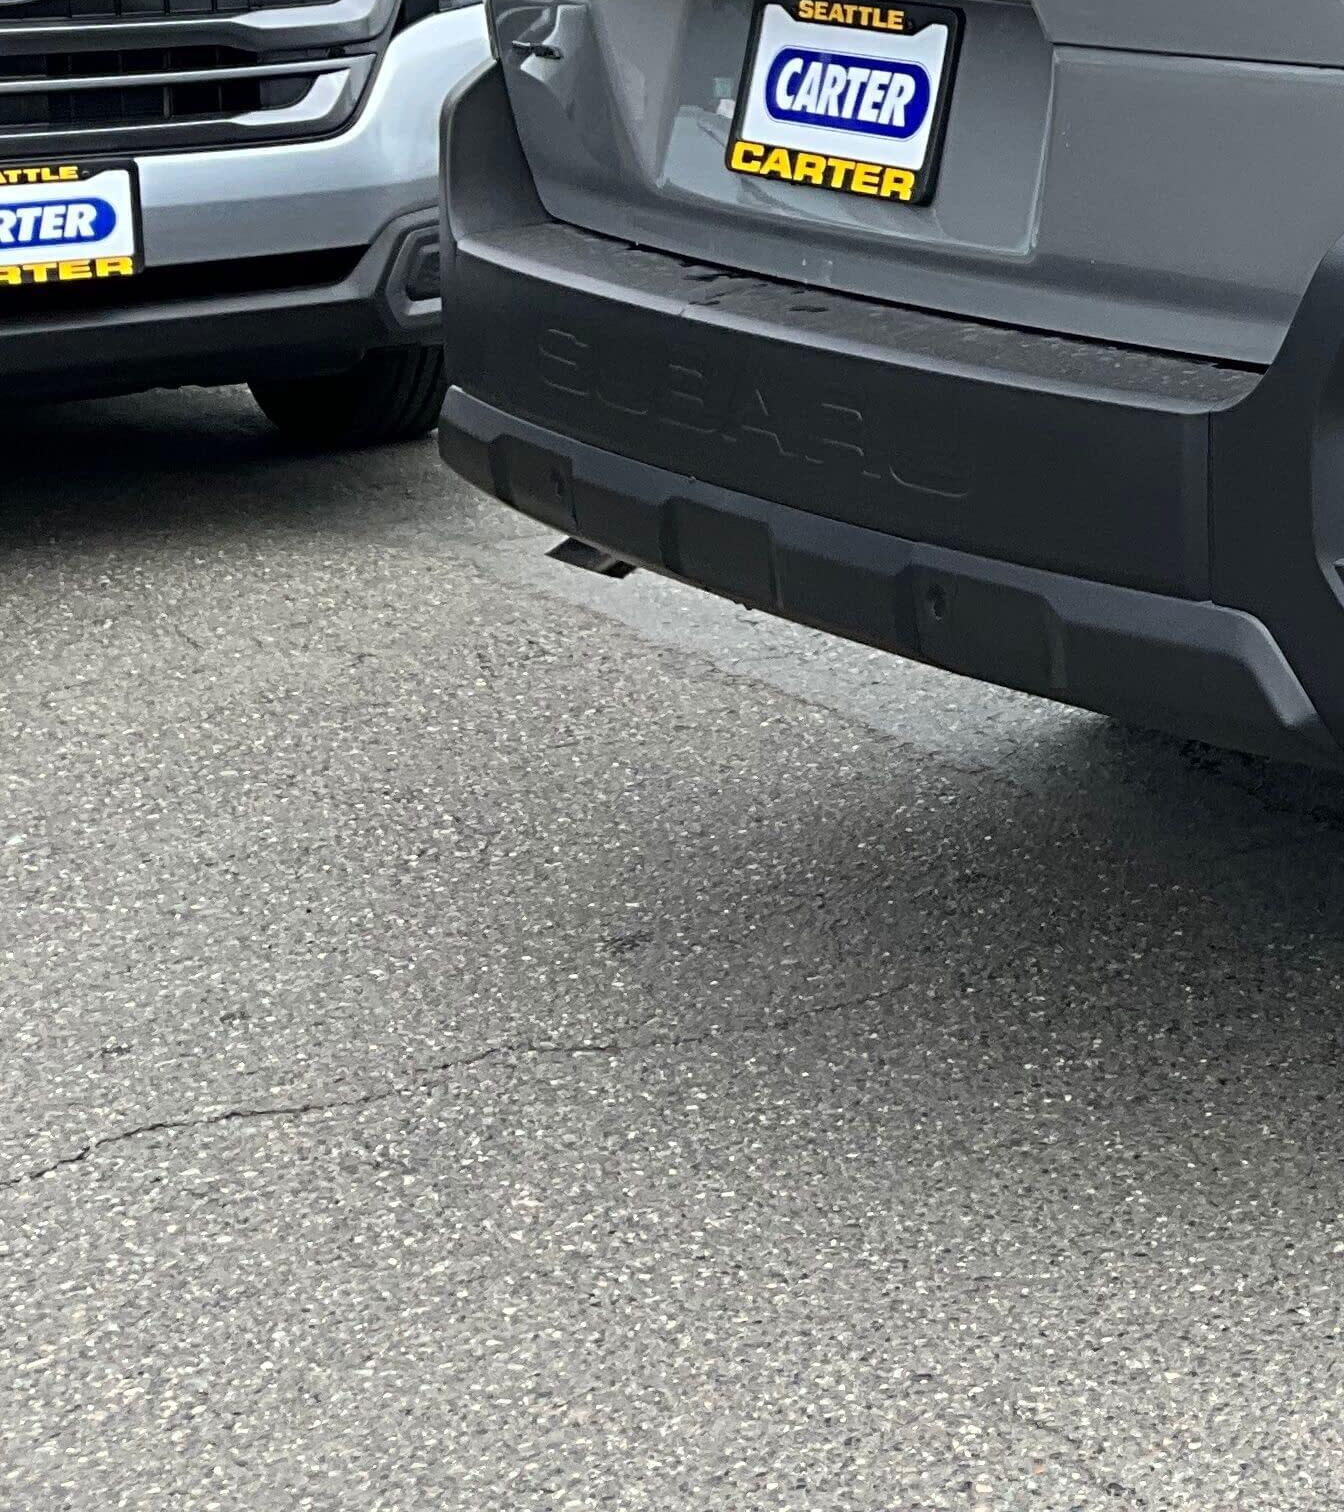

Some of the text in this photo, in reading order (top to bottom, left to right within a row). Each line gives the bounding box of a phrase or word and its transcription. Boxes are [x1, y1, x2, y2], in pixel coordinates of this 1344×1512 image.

[798, 0, 905, 30] SEATTLE
[775, 57, 916, 128] CARTER
[731, 141, 916, 201] CARTER
